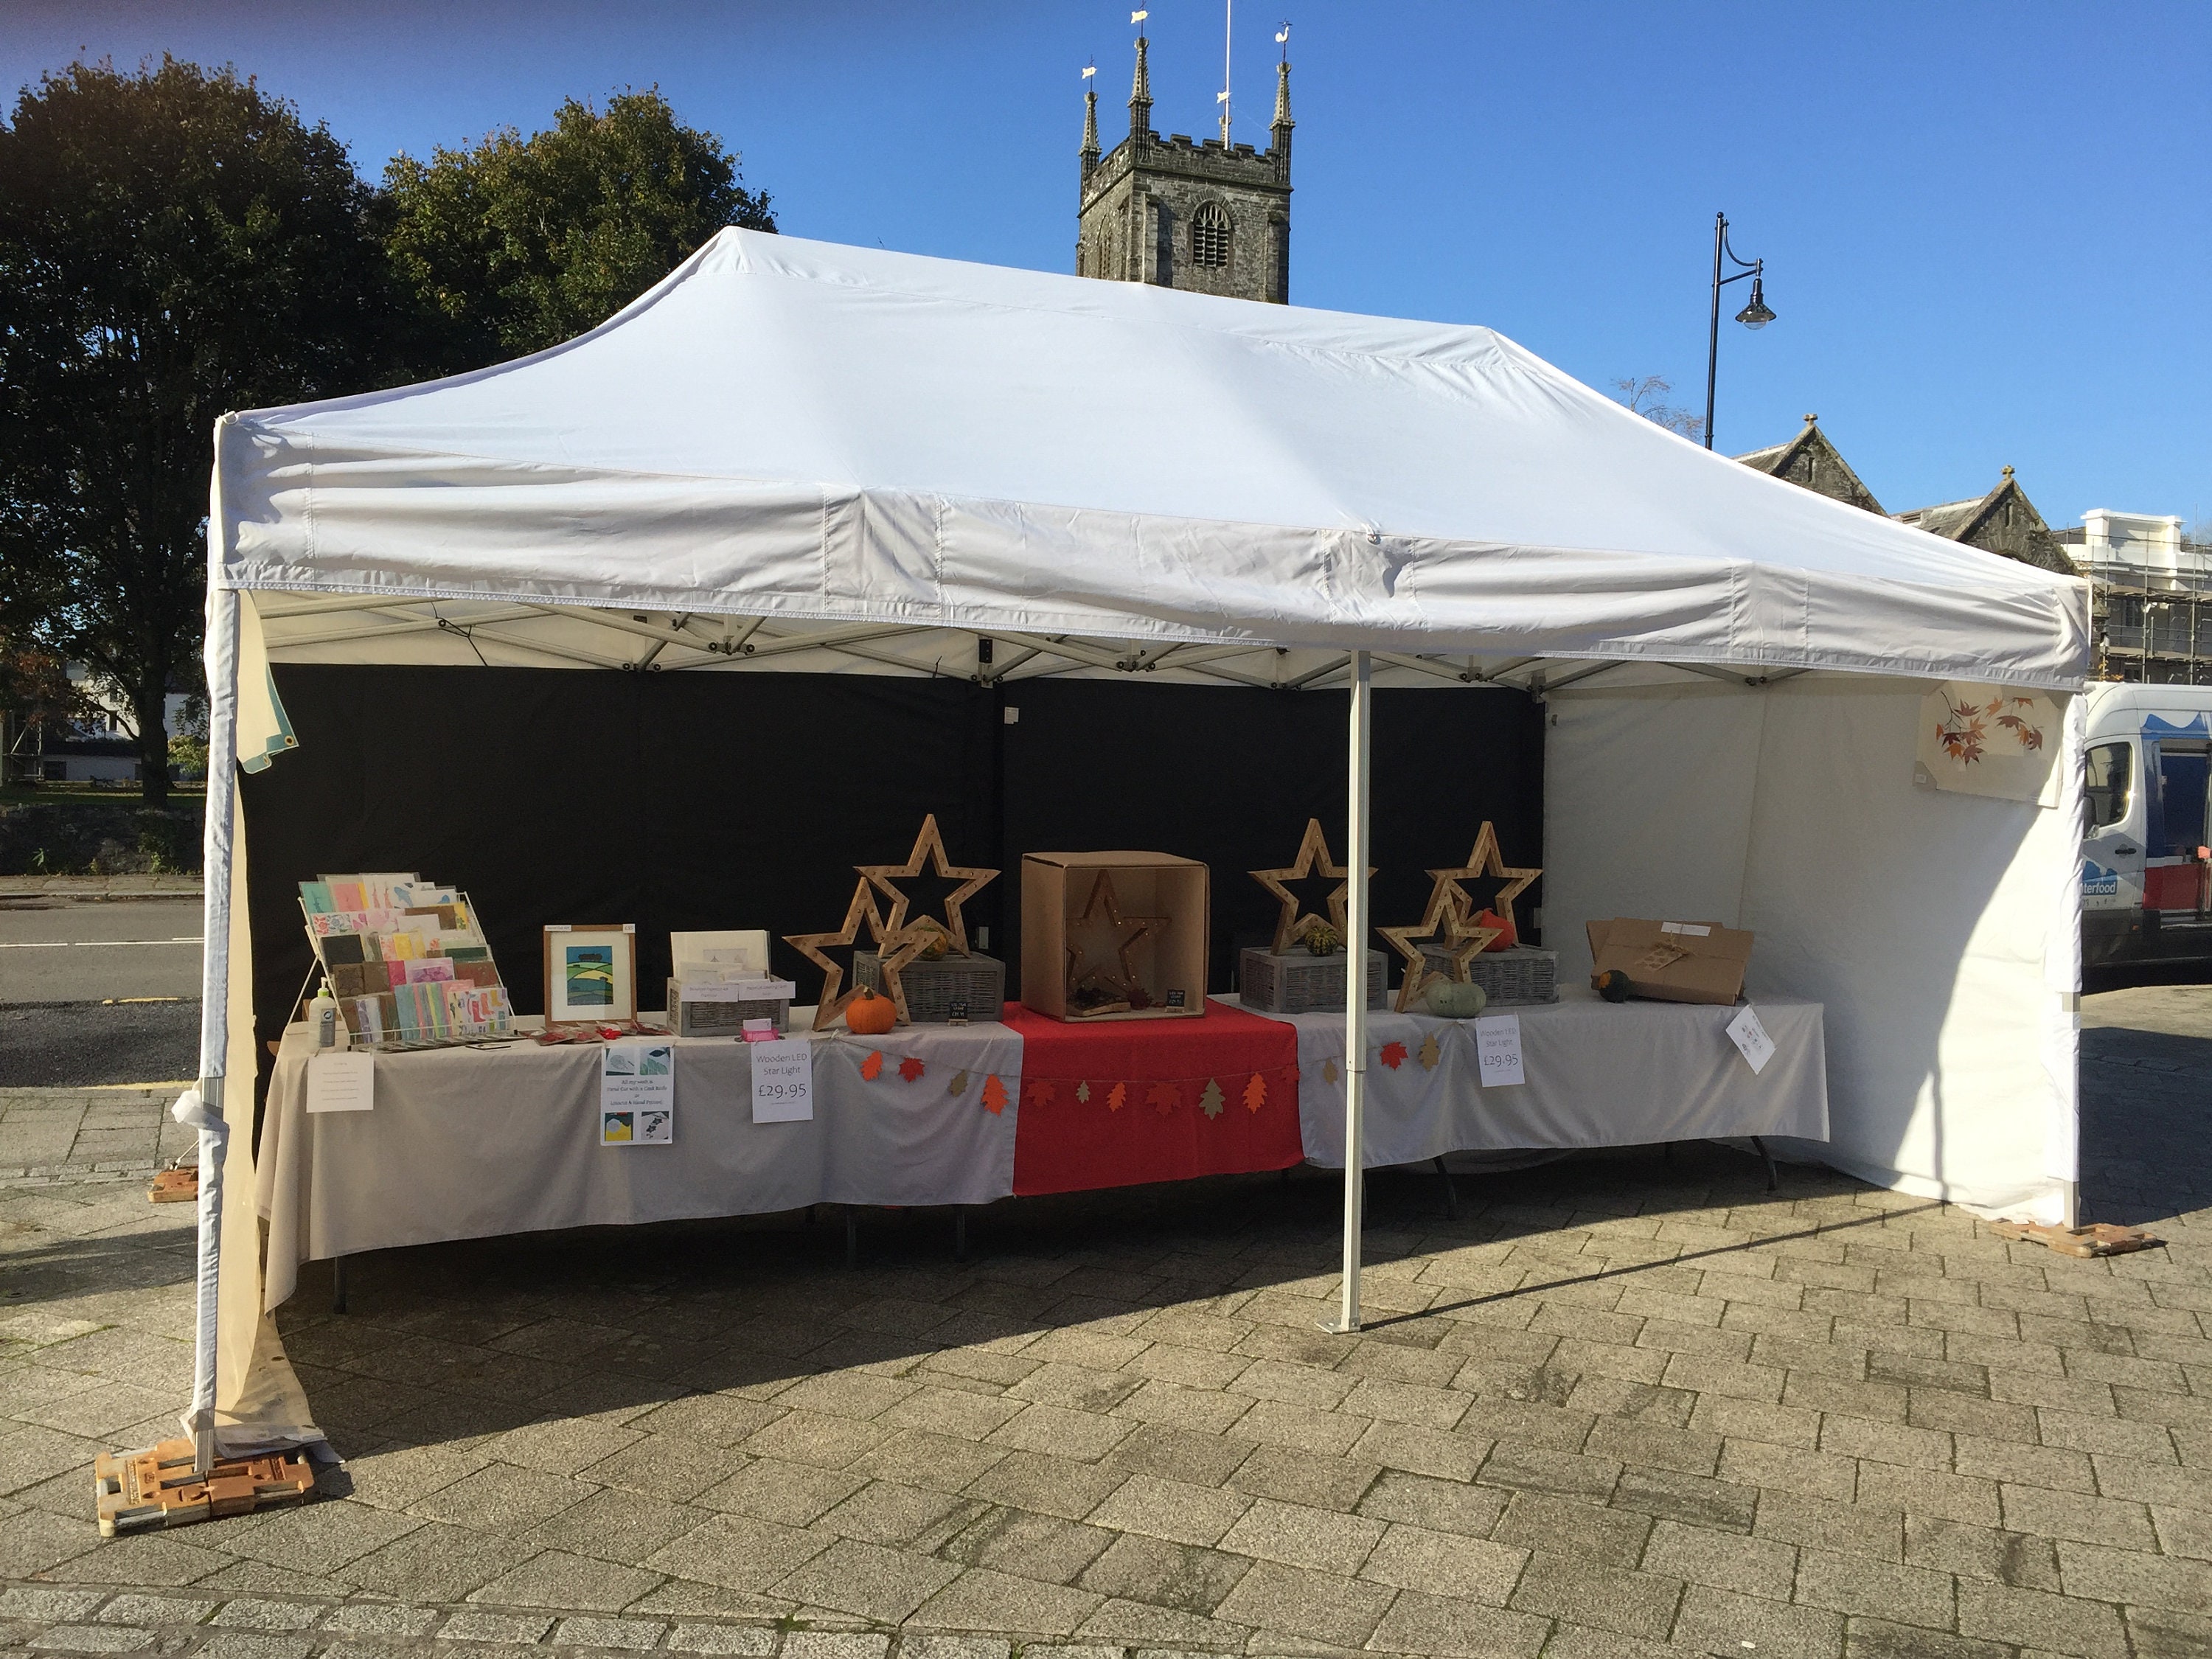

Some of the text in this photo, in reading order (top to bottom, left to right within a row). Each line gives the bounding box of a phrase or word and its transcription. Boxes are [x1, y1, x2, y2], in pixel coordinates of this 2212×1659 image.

[2084, 882, 2116, 894] terfood
[756, 1053, 807, 1062] Wooden LED
[1484, 1054, 1518, 1067] £29.95
[763, 1065, 801, 1077] Star Light
[759, 1083, 807, 1099] £29.95
